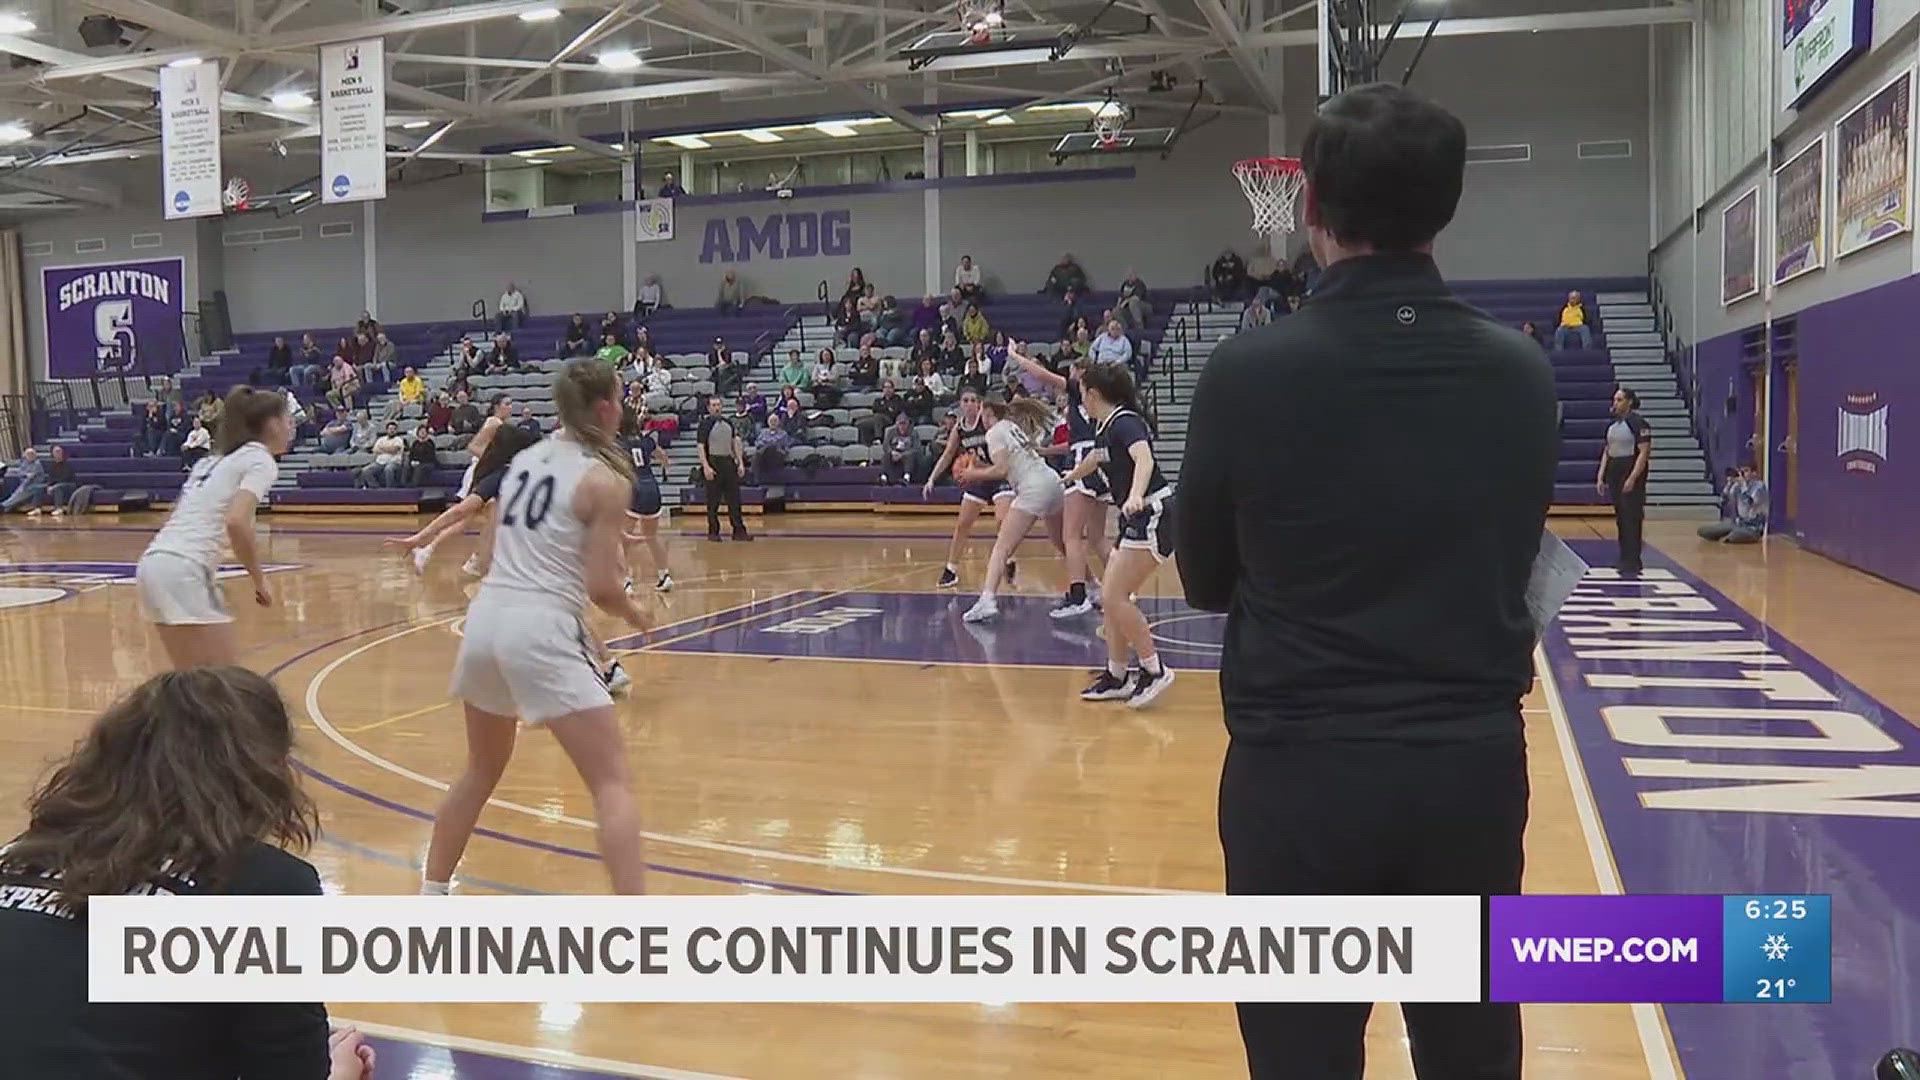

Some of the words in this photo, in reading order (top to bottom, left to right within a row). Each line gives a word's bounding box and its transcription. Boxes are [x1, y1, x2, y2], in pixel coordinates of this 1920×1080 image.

[698, 209, 851, 264] AMDG
[59, 269, 170, 311] SCRANTON
[502, 469, 556, 530] 20
